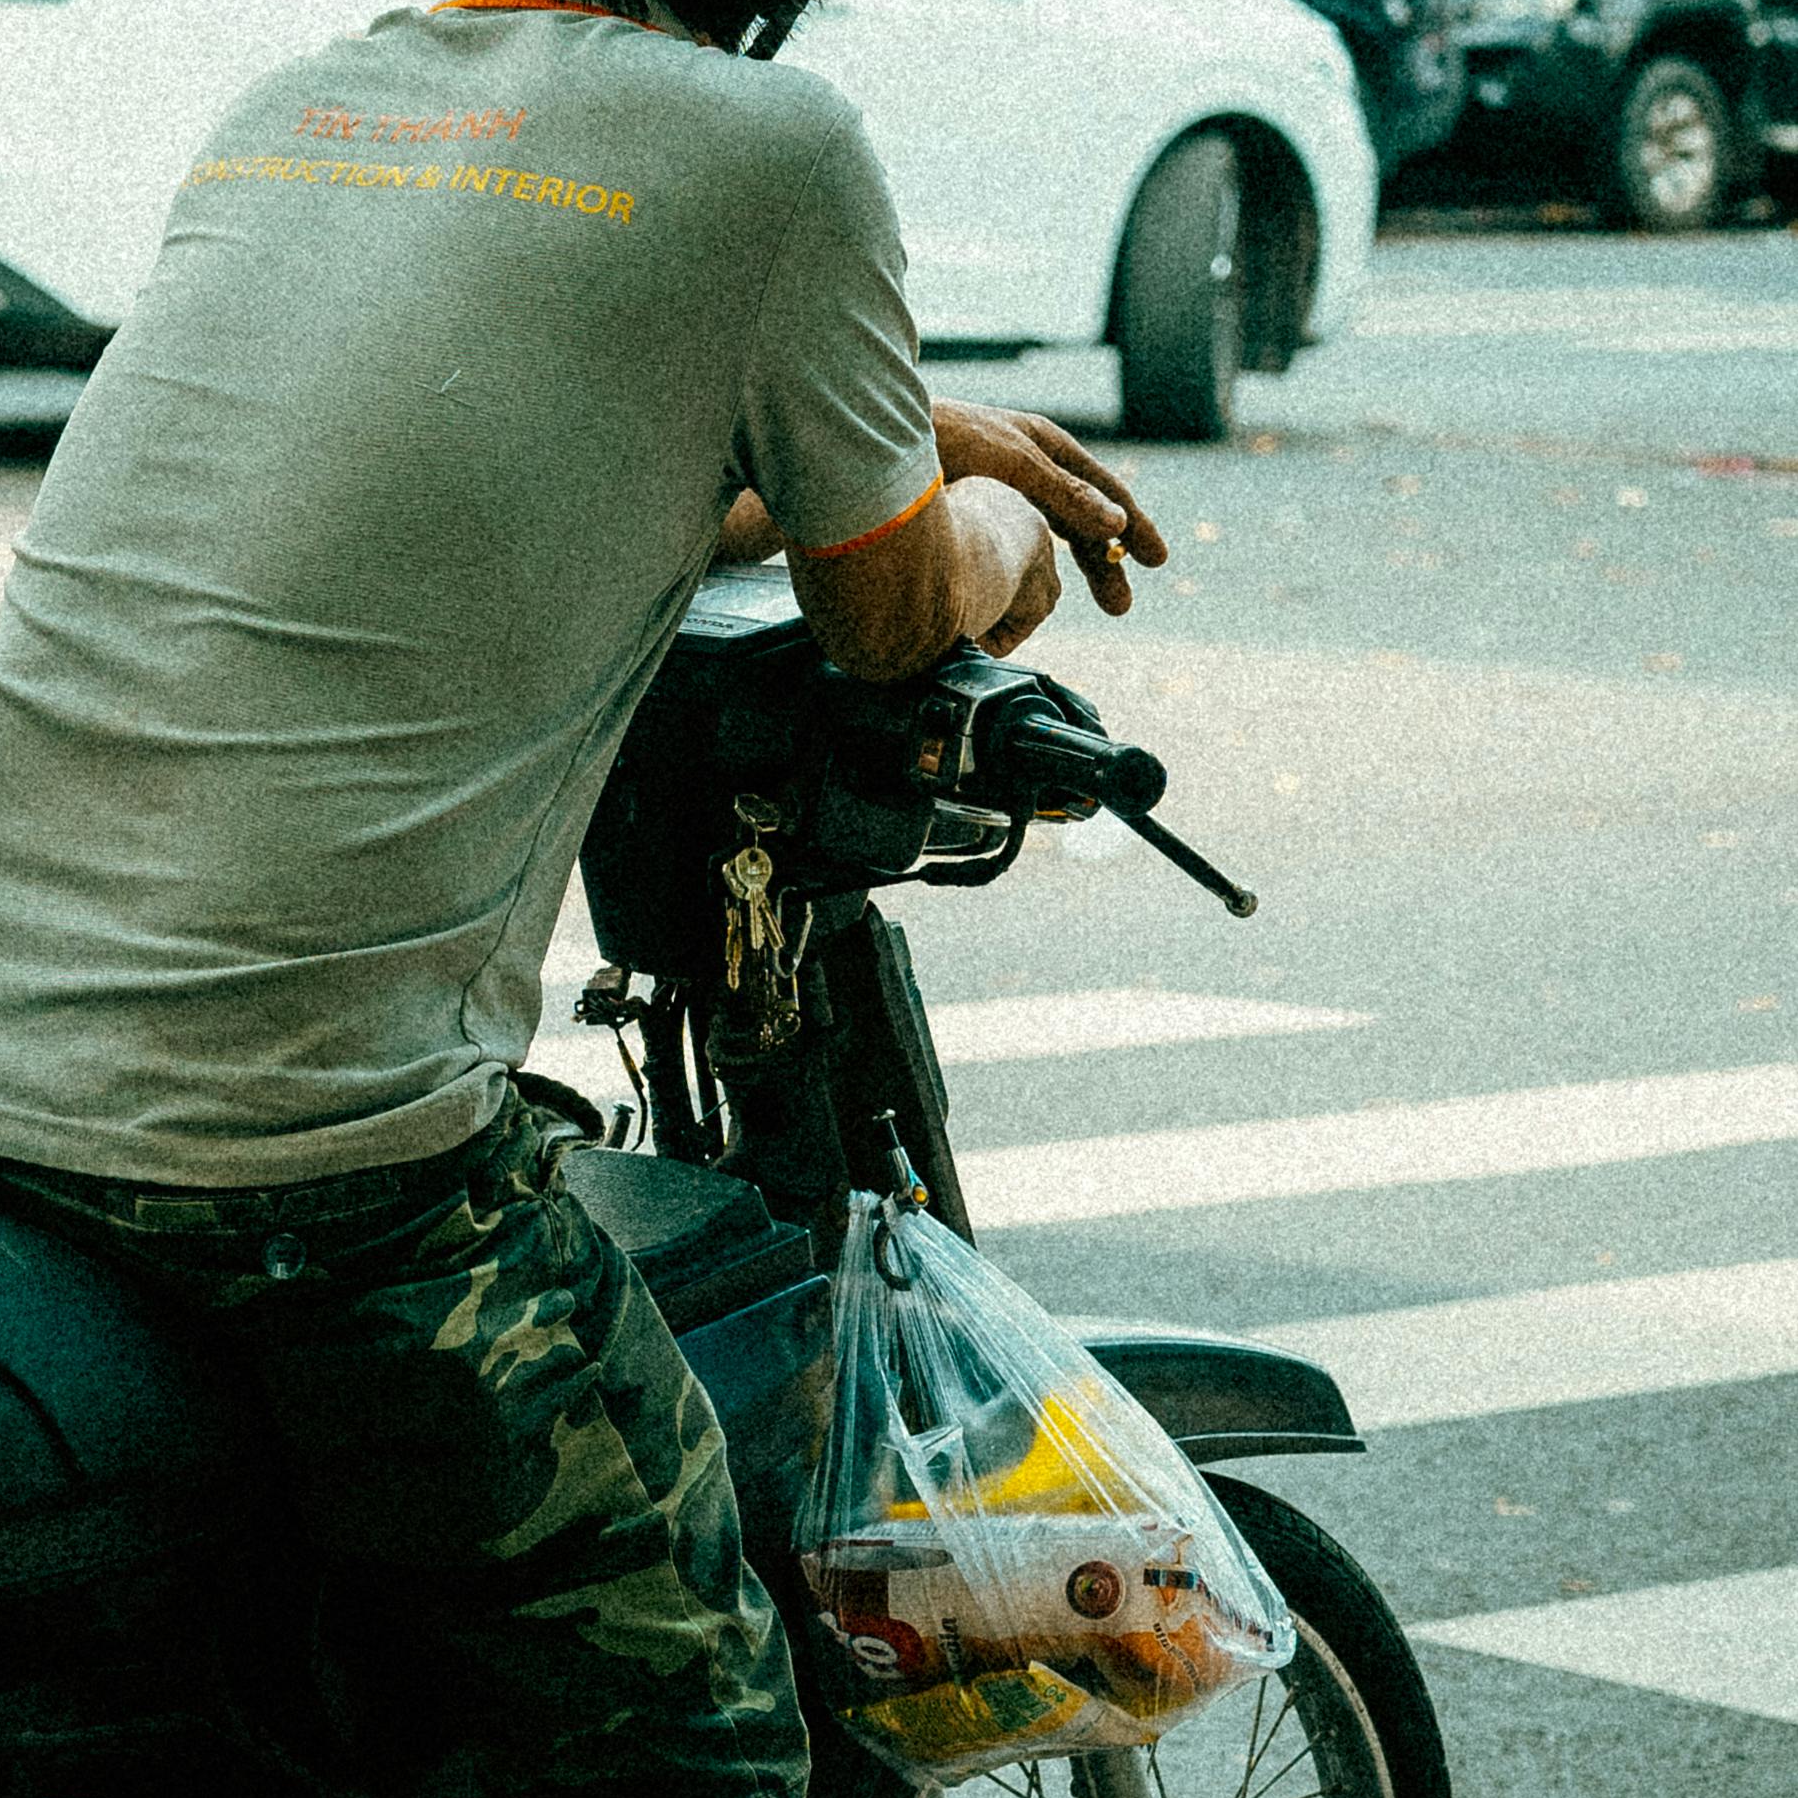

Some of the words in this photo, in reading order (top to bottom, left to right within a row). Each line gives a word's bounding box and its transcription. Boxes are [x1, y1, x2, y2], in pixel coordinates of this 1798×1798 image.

[182, 156, 412, 190] ONSTRUCTION
[416, 163, 446, 190] &
[449, 163, 636, 225] INTERIOR
